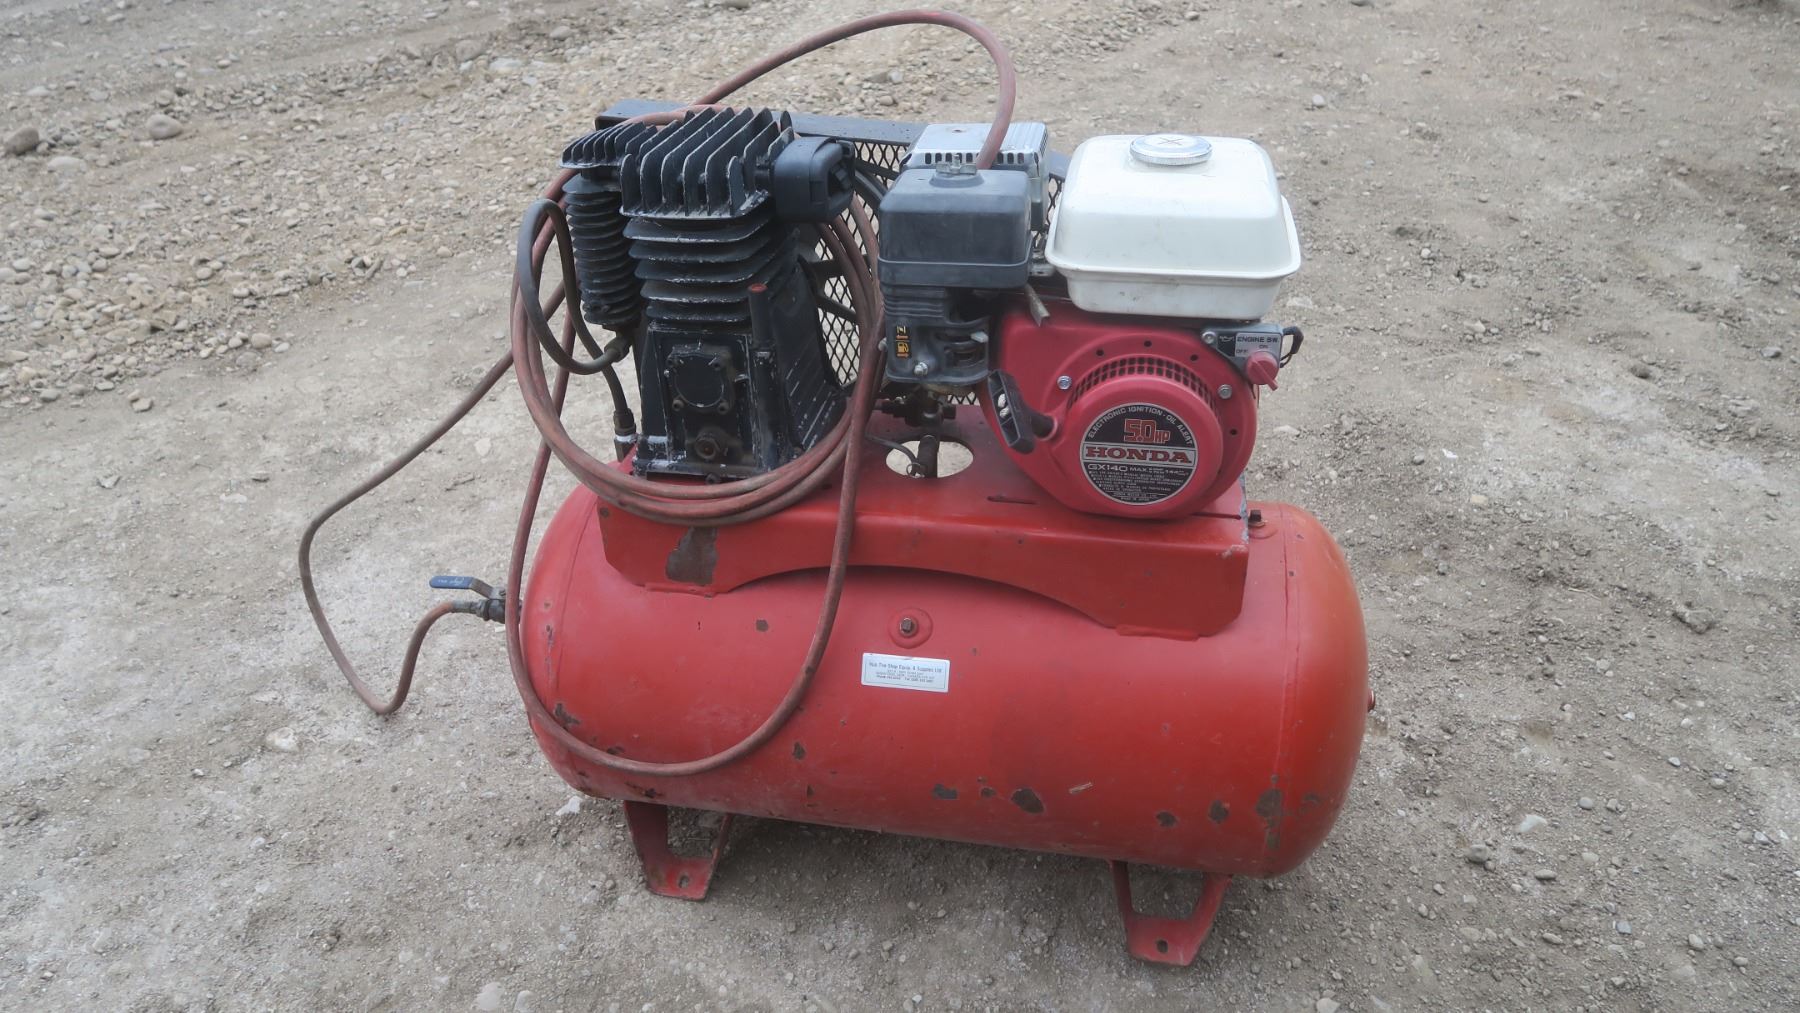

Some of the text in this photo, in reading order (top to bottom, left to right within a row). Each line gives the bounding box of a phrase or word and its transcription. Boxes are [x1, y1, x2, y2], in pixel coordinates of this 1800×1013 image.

[1088, 406, 1127, 439] ELECTRONIC
[1128, 406, 1163, 417] IGNITION
[1165, 414, 1177, 425] OIL
[1177, 424, 1193, 445] ALERT
[1085, 446, 1192, 463] HONDA
[1087, 463, 1128, 472] GX140
